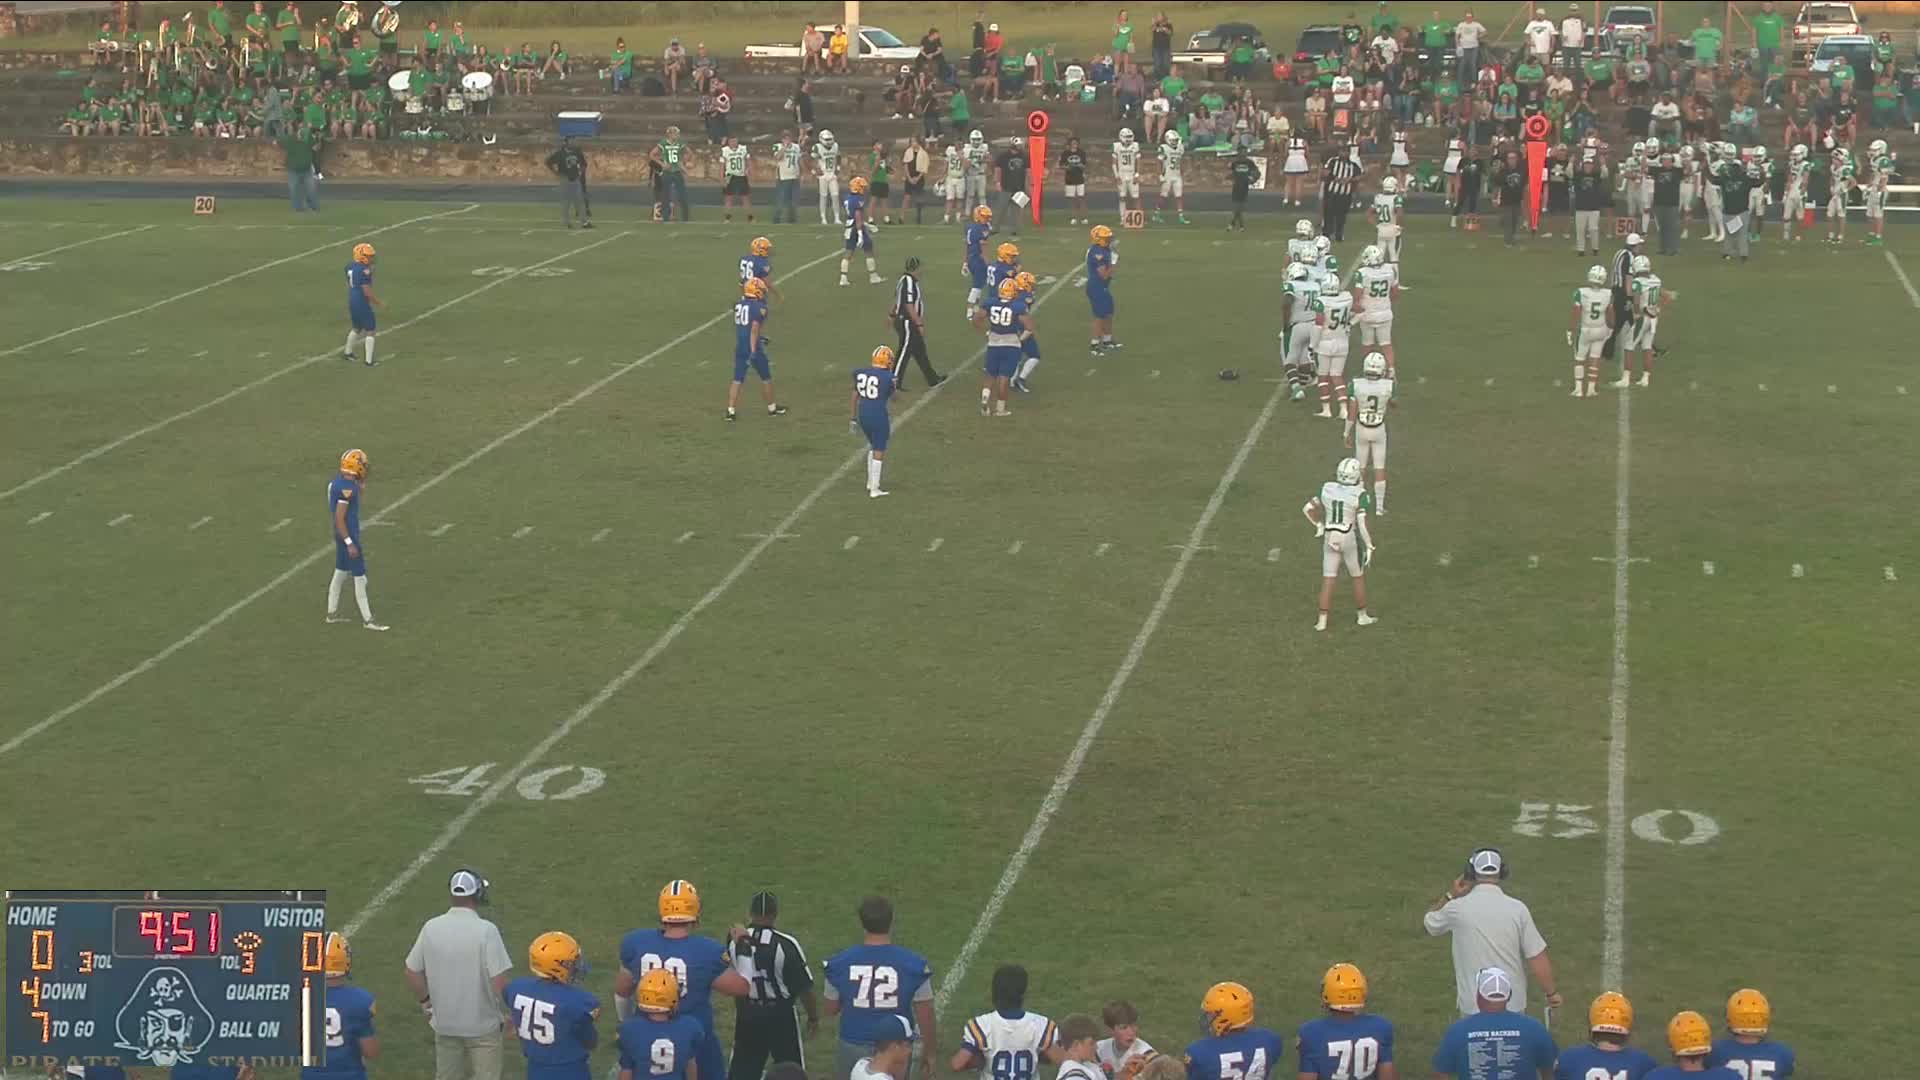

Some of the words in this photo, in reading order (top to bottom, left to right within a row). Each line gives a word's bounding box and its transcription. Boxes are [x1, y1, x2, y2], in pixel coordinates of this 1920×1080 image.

[667, 150, 679, 163] 16
[730, 157, 742, 171] 60
[786, 156, 797, 169] 74
[1122, 154, 1132, 165] 31
[196, 199, 212, 211] 20
[1377, 204, 1391, 223] 20
[1126, 213, 1142, 225] 40
[1617, 219, 1633, 233] 50
[740, 260, 754, 278] 56
[1370, 280, 1388, 297] 52
[735, 304, 750, 325] 20
[990, 306, 1013, 326] 50
[1328, 306, 1351, 330] 54
[1590, 302, 1601, 320] 5
[856, 373, 879, 399] 26
[1367, 395, 1378, 413] 3
[1331, 500, 1344, 523] 11
[407, 762, 607, 800] 40
[1512, 801, 1721, 845] 50
[849, 965, 898, 1009] 72
[512, 993, 556, 1045] 75
[650, 1038, 675, 1074] 9
[1219, 1047, 1266, 1080] 54
[1327, 1036, 1379, 1080] 70
